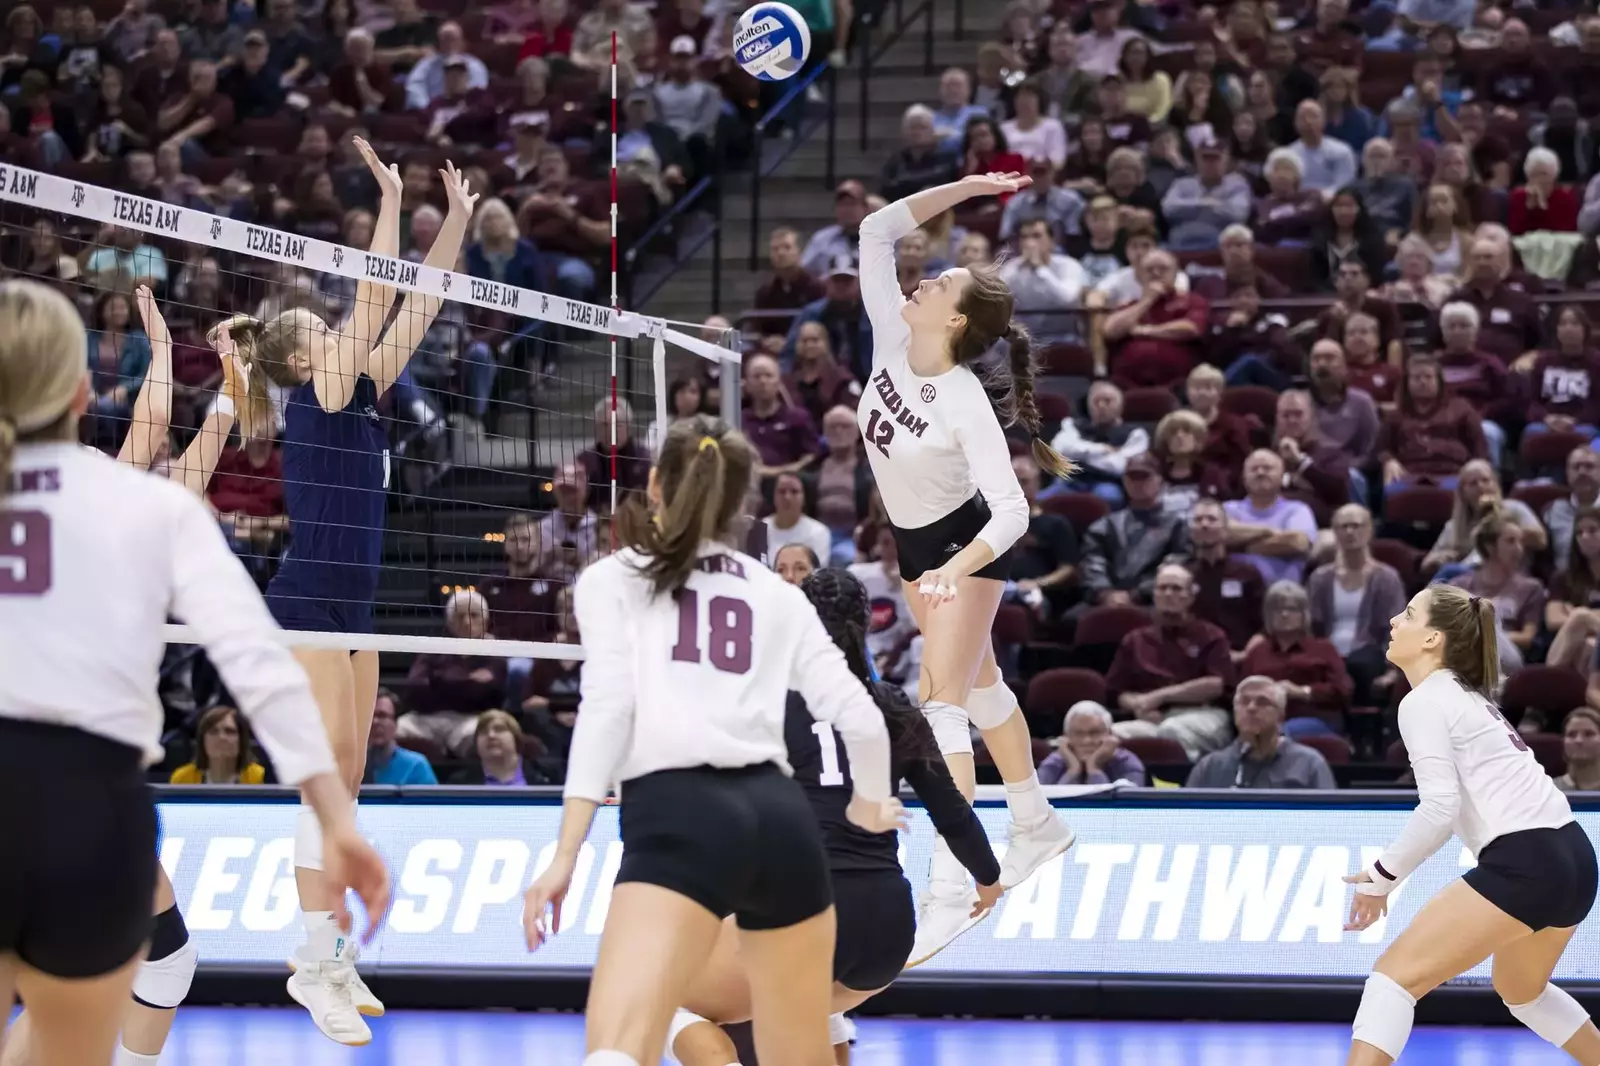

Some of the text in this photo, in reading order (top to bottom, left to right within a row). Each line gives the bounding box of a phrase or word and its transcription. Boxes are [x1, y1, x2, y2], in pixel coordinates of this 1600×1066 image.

[735, 22, 770, 48] molten
[741, 37, 772, 61] NCAA
[10, 171, 38, 198] A&M
[113, 195, 180, 232] TEXAS A&M
[247, 227, 306, 261] TEXAS A&M
[365, 255, 418, 286] TEXAS A&M
[471, 280, 499, 305] TEXAS
[566, 302, 592, 325] TEXAS
[873, 368, 930, 438] TEXAS A&M
[865, 409, 895, 460] 12
[672, 589, 753, 675] 18
[811, 720, 844, 786] 1
[985, 842, 1408, 943] ATHWAY
